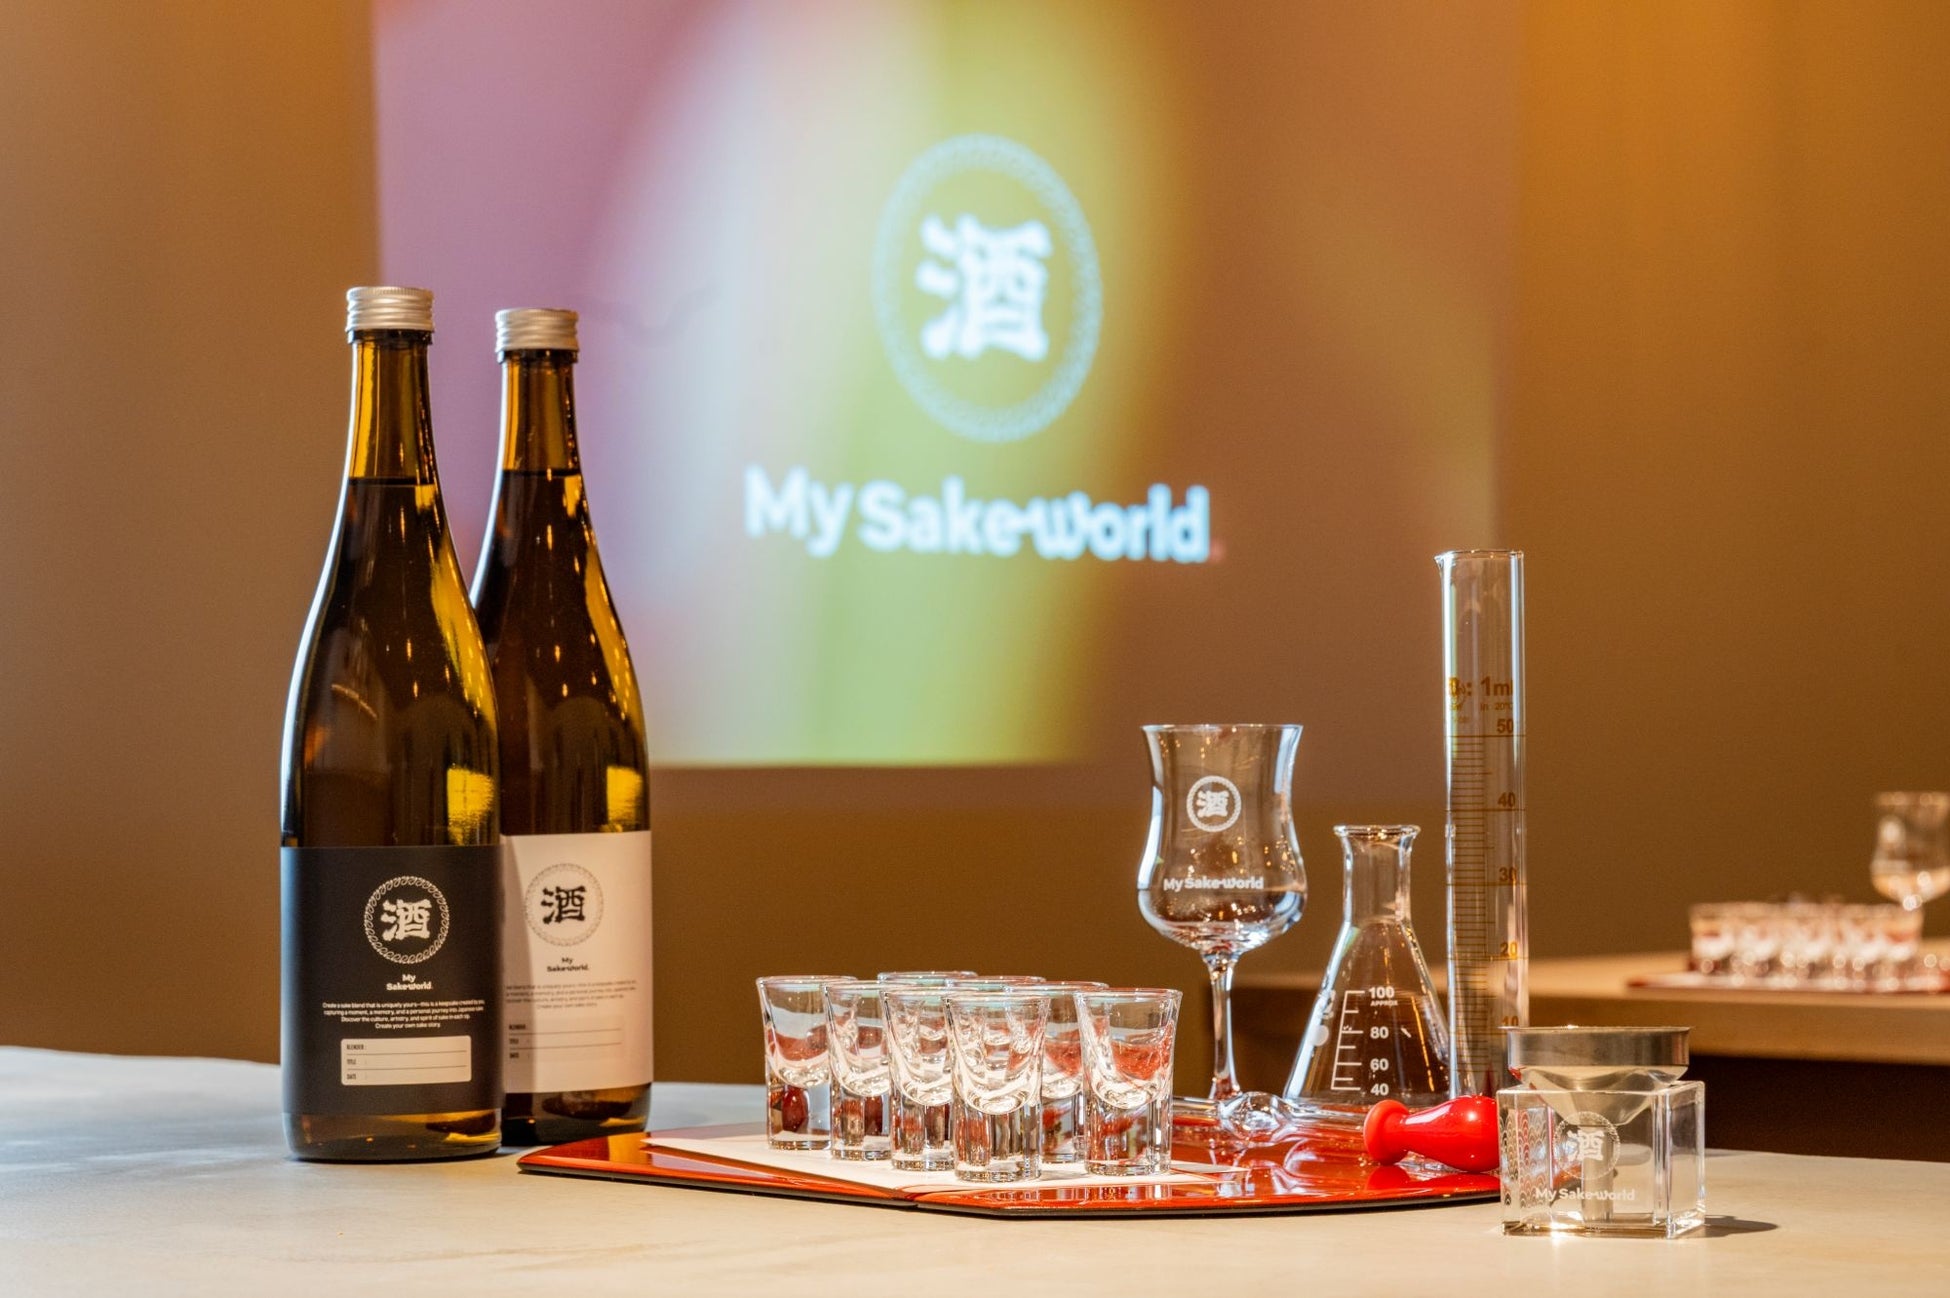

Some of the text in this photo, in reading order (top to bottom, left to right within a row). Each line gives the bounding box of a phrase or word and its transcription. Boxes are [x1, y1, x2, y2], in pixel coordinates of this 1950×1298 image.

[916, 213, 1052, 362] 酒
[744, 464, 855, 559] My
[1497, 718, 1514, 734] 50
[1195, 789, 1230, 818] 酒
[1497, 792, 1516, 808] 40
[1499, 867, 1517, 882] 30
[1163, 878, 1183, 892] My
[541, 886, 587, 925] 酒
[381, 899, 432, 941] 酒
[1500, 941, 1518, 957] 20
[561, 957, 574, 965] My
[402, 974, 416, 983] My
[1369, 986, 1395, 999] 100
[1370, 1026, 1389, 1039] 80
[1370, 1058, 1389, 1071] 60
[1370, 1083, 1389, 1096] 40
[1566, 1129, 1604, 1161] 酒
[1535, 1187, 1557, 1202] My
